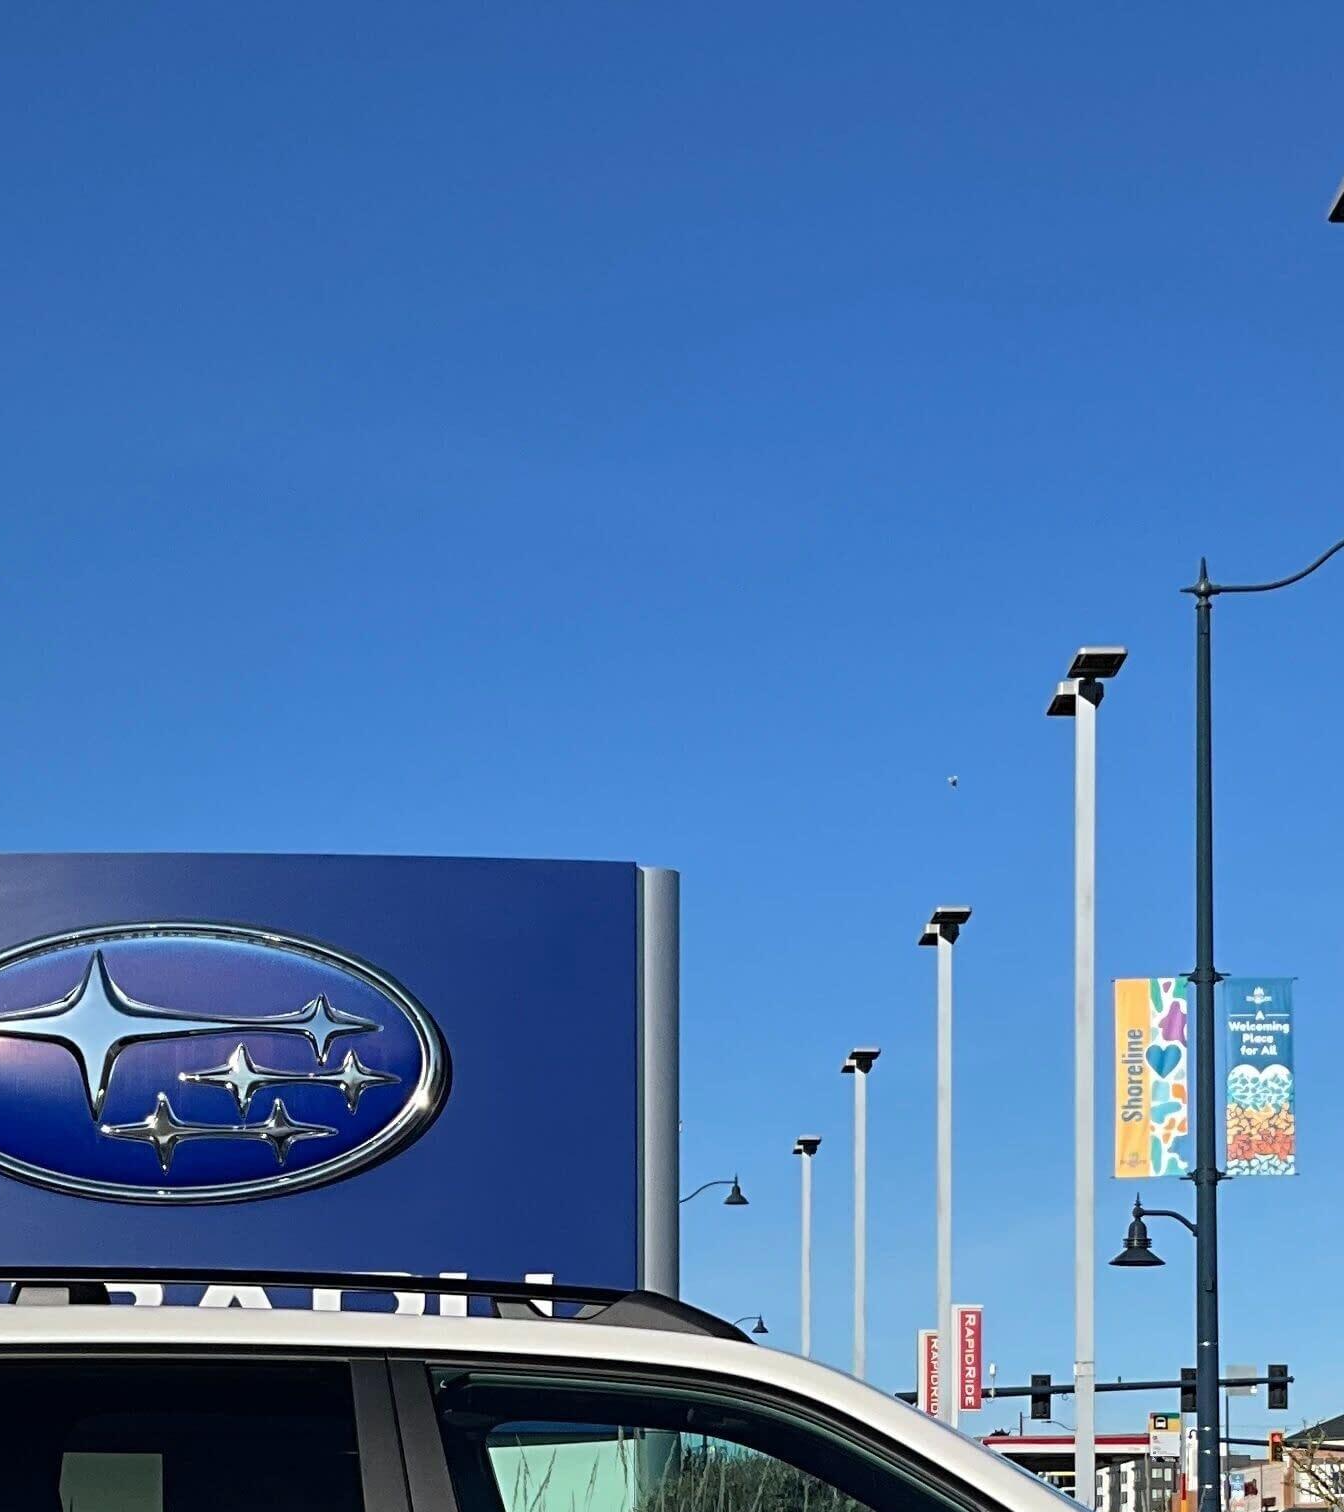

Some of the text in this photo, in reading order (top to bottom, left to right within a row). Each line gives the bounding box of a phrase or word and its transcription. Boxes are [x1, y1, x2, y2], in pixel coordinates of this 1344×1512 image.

[1255, 1010, 1265, 1021] A
[1228, 1020, 1290, 1034] Welcoming
[1242, 1032, 1274, 1044] Place
[1240, 1044, 1278, 1056] for All
[1121, 1029, 1143, 1122] Shoreline
[965, 1314, 976, 1406] RAPIDRIDE
[930, 1338, 939, 1418] RAPIDRID
